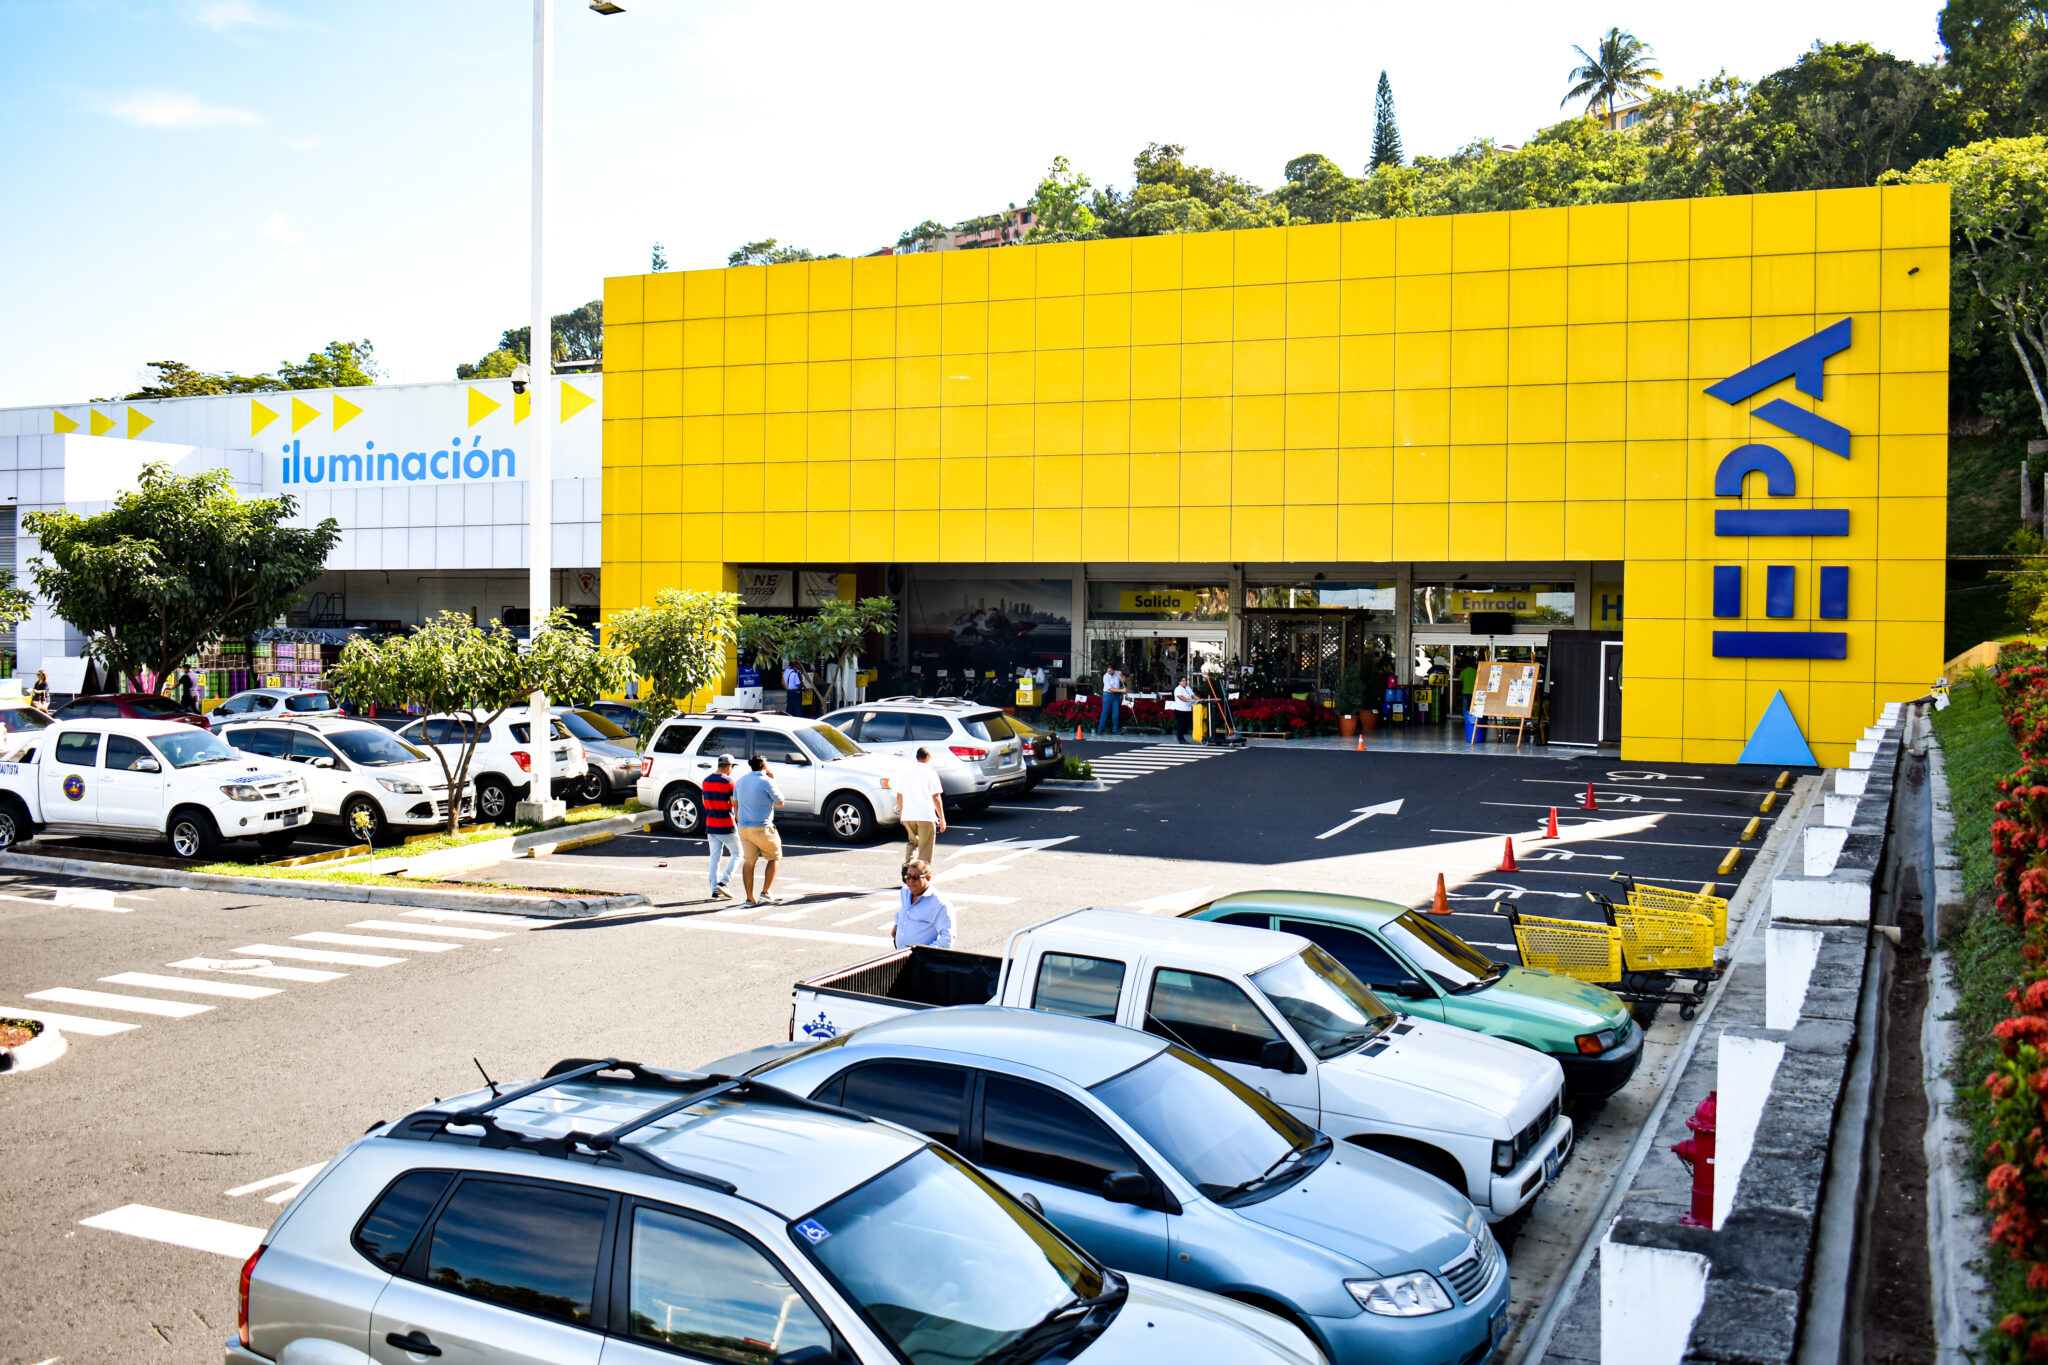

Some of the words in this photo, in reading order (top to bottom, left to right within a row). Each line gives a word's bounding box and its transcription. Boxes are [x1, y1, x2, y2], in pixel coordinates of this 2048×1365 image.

[282, 434, 516, 484] iluminación
[1703, 316, 1853, 660] EPA
[744, 587, 777, 596] TIRES
[1135, 594, 1181, 608] Salida
[1462, 596, 1527, 611] Entrada
[1432, 674, 1447, 685] 2x1
[1416, 690, 1429, 701] 2x1
